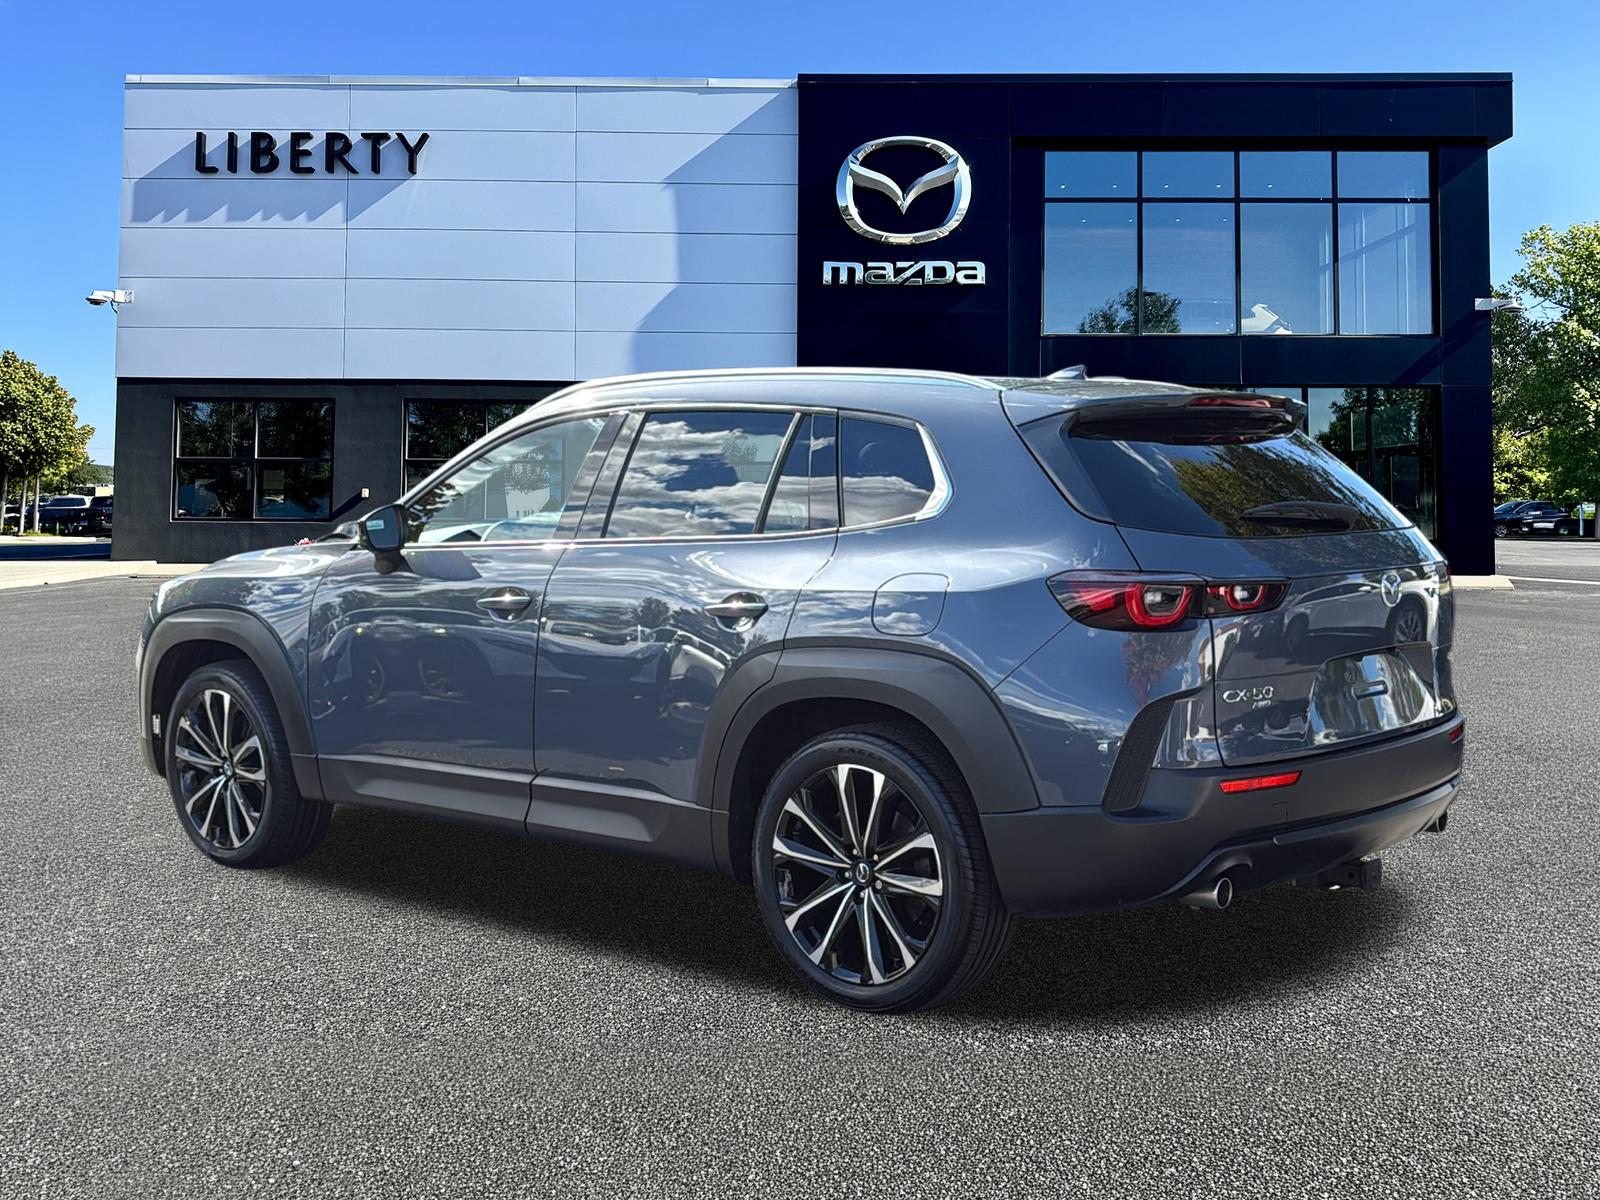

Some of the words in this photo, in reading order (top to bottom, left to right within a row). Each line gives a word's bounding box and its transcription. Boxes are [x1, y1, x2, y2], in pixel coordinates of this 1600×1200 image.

[195, 131, 430, 174] LIBERTY
[823, 261, 986, 285] mazda
[1223, 686, 1274, 702] CX-50
